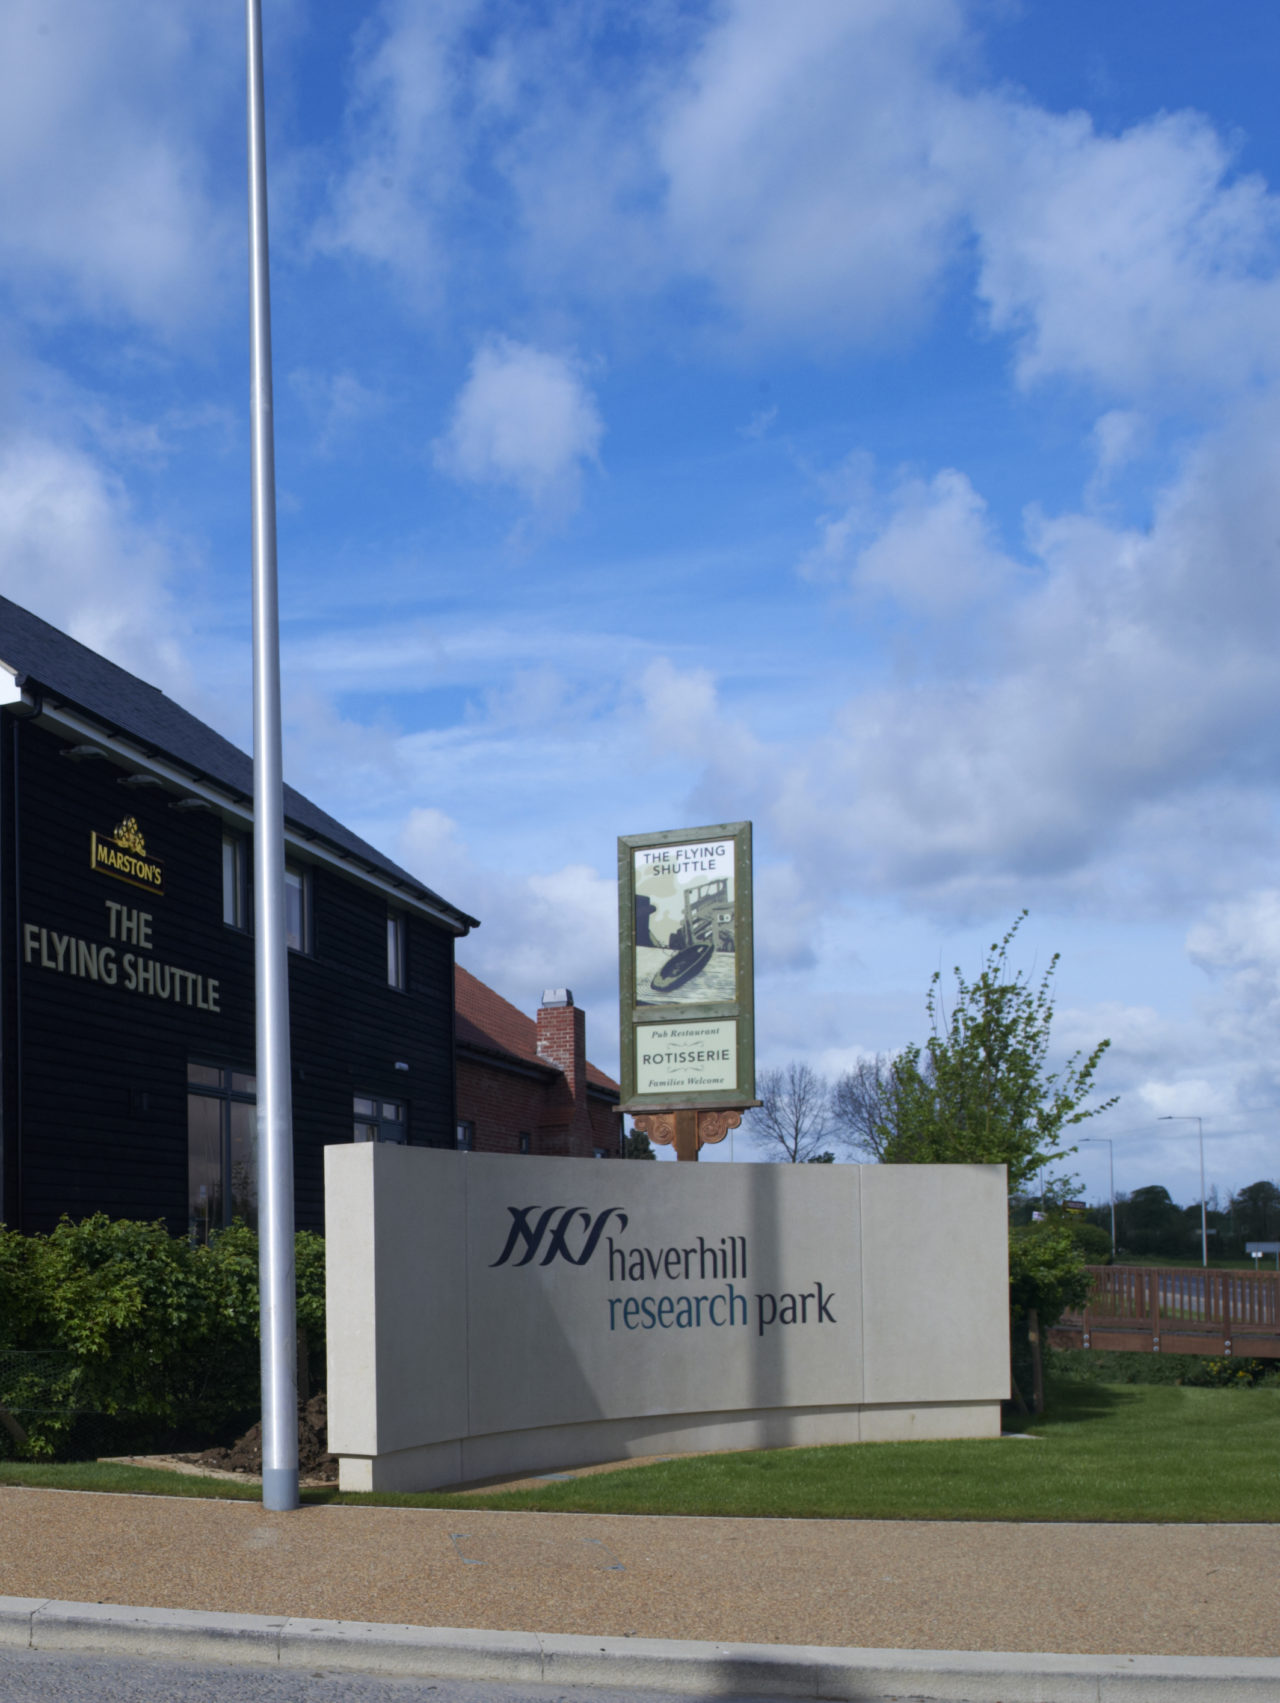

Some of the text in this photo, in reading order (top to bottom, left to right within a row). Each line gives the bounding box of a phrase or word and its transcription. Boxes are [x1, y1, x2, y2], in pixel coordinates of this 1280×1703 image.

[97, 843, 162, 885] MARSTON'S
[644, 845, 726, 864] THE FLYING
[653, 859, 716, 876] SHUTTLE
[105, 900, 153, 949] THE
[24, 923, 221, 1012] FLYING SHUTTLE
[652, 1027, 720, 1039] Pub Restaurant
[643, 1049, 730, 1065] ROTISSERIE
[648, 1077, 725, 1088] Families Welcome
[605, 1236, 748, 1282] haverhill
[607, 1281, 837, 1336] research park
